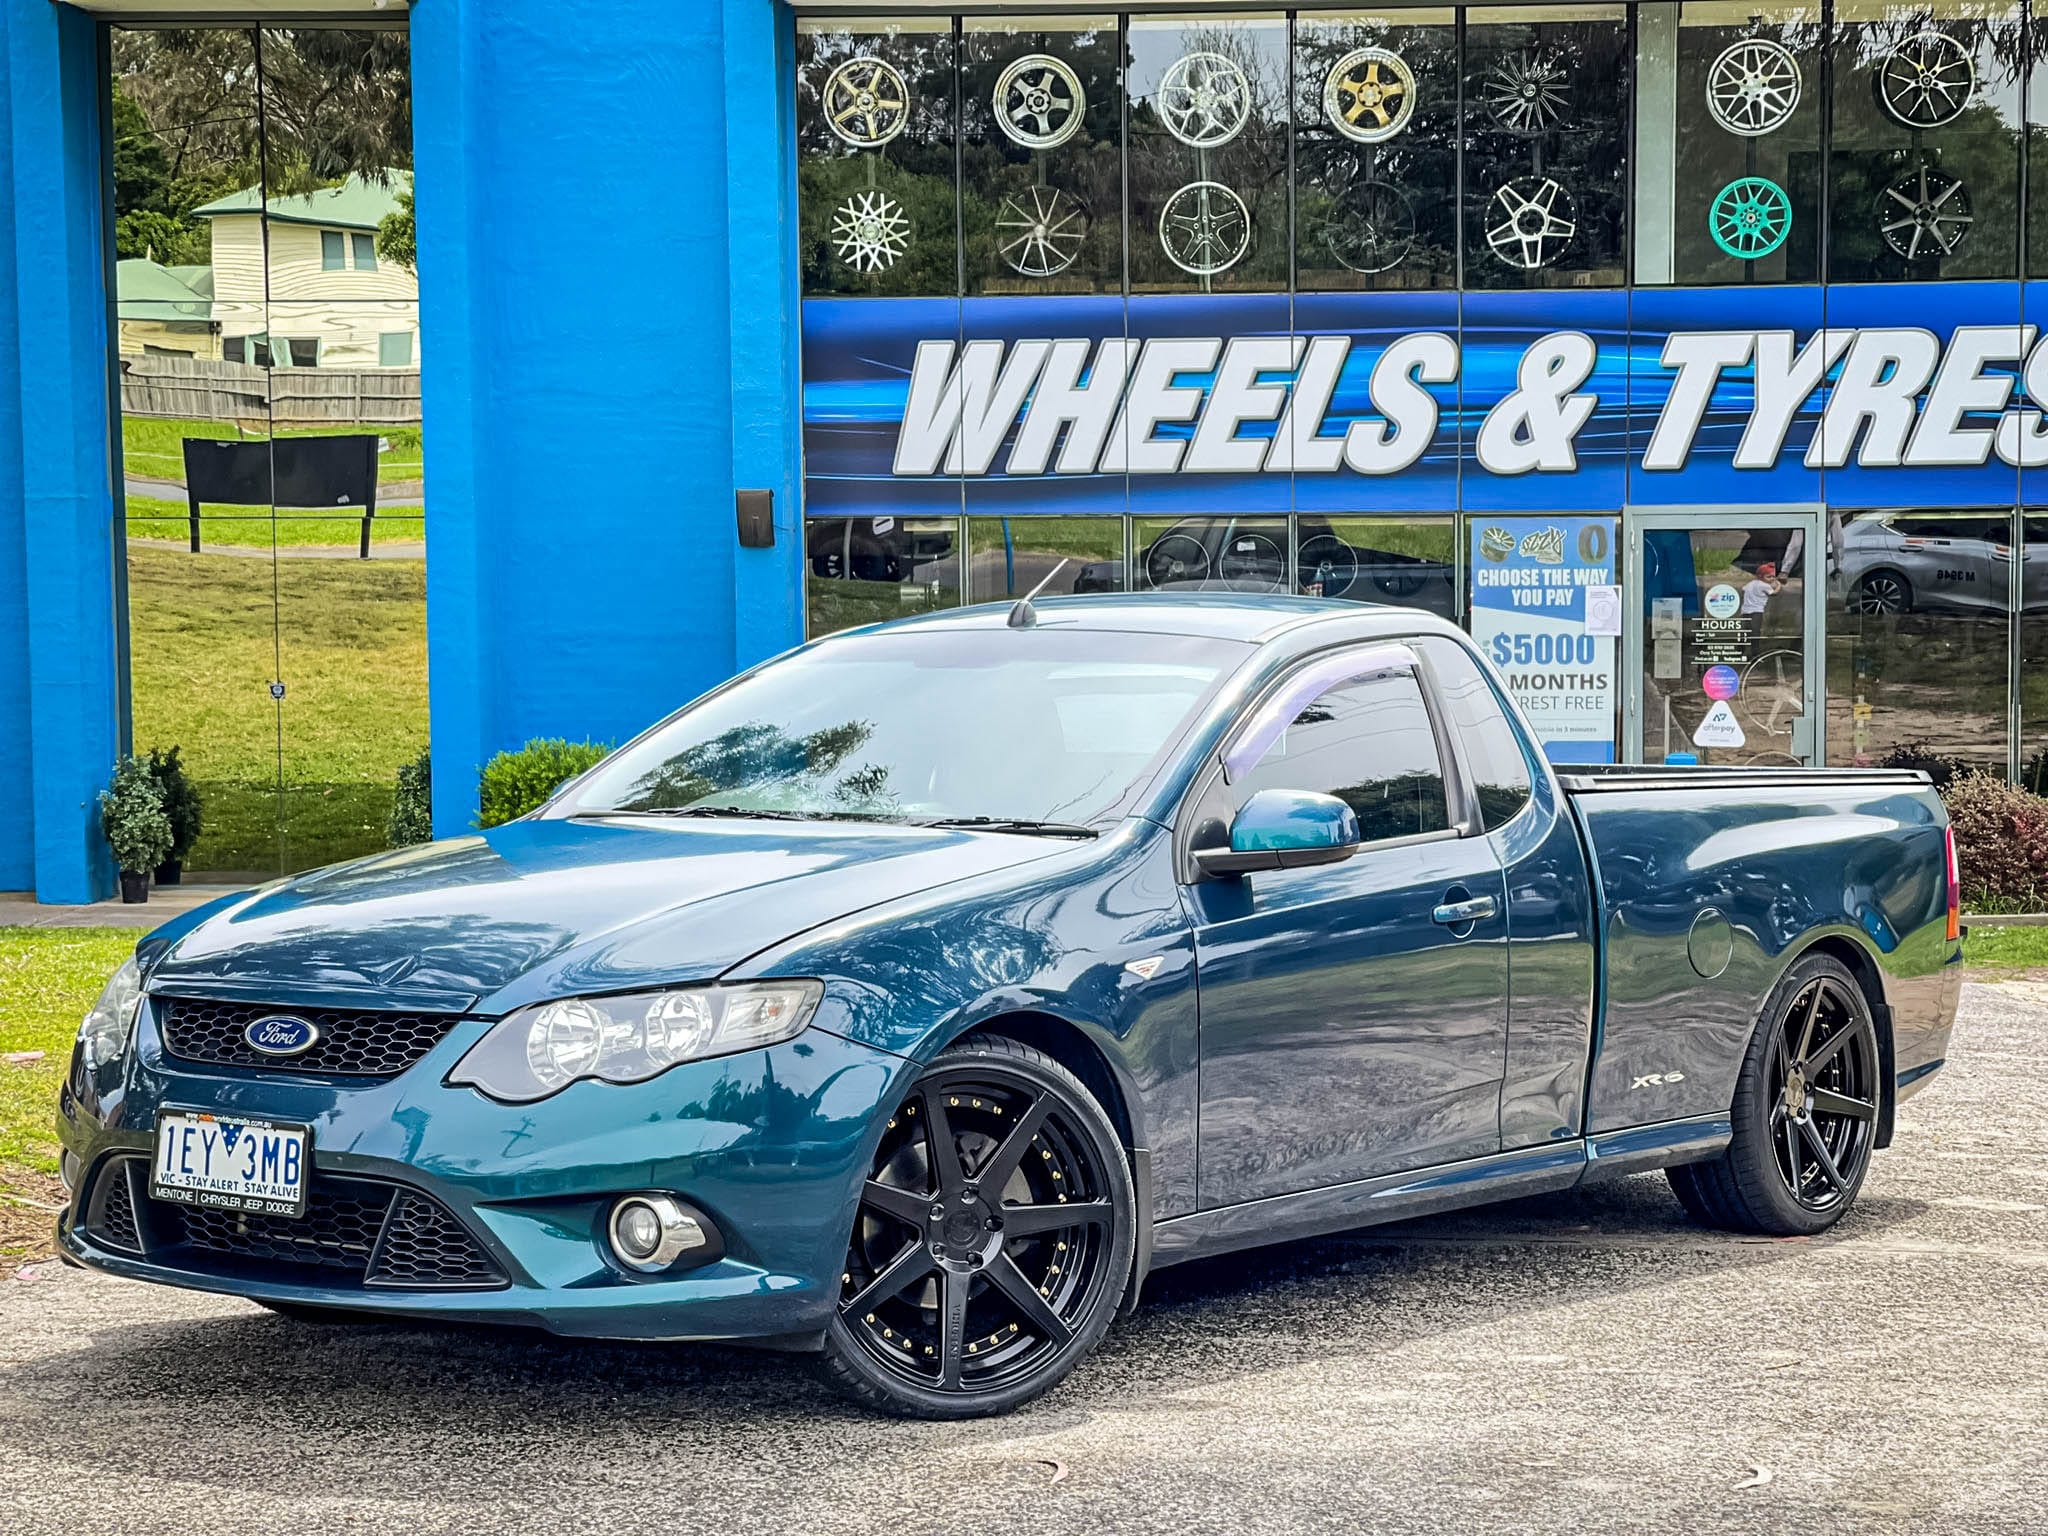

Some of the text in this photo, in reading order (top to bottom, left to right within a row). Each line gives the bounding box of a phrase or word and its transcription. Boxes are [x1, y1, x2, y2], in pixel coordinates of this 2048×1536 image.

[892, 332, 1460, 475] WHEELS
[1475, 330, 1599, 475] &
[1477, 567, 1609, 587] CHOOSE THE WAY
[1511, 588, 1543, 607] YOU
[1545, 588, 1575, 607] PAY
[1720, 593, 1736, 603] zip
[1701, 620, 1742, 630] HOURS
[1492, 631, 1596, 669] $5000
[1509, 673, 1608, 691] MONTHS
[1514, 695, 1605, 710] REST FREE
[1703, 722, 1736, 734] afterpay
[258, 1021, 300, 1045] Ford
[1631, 1070, 1685, 1090] XR6
[166, 1125, 301, 1186] 1EY 3MB
[160, 1172, 176, 1185] VIC
[185, 1175, 208, 1188] STAY
[208, 1177, 239, 1191] ALERT
[244, 1183, 271, 1196] STAY
[271, 1185, 299, 1199] ALIVE
[155, 1186, 295, 1215] MENTONE CHRYSLER JEEP DODGE
